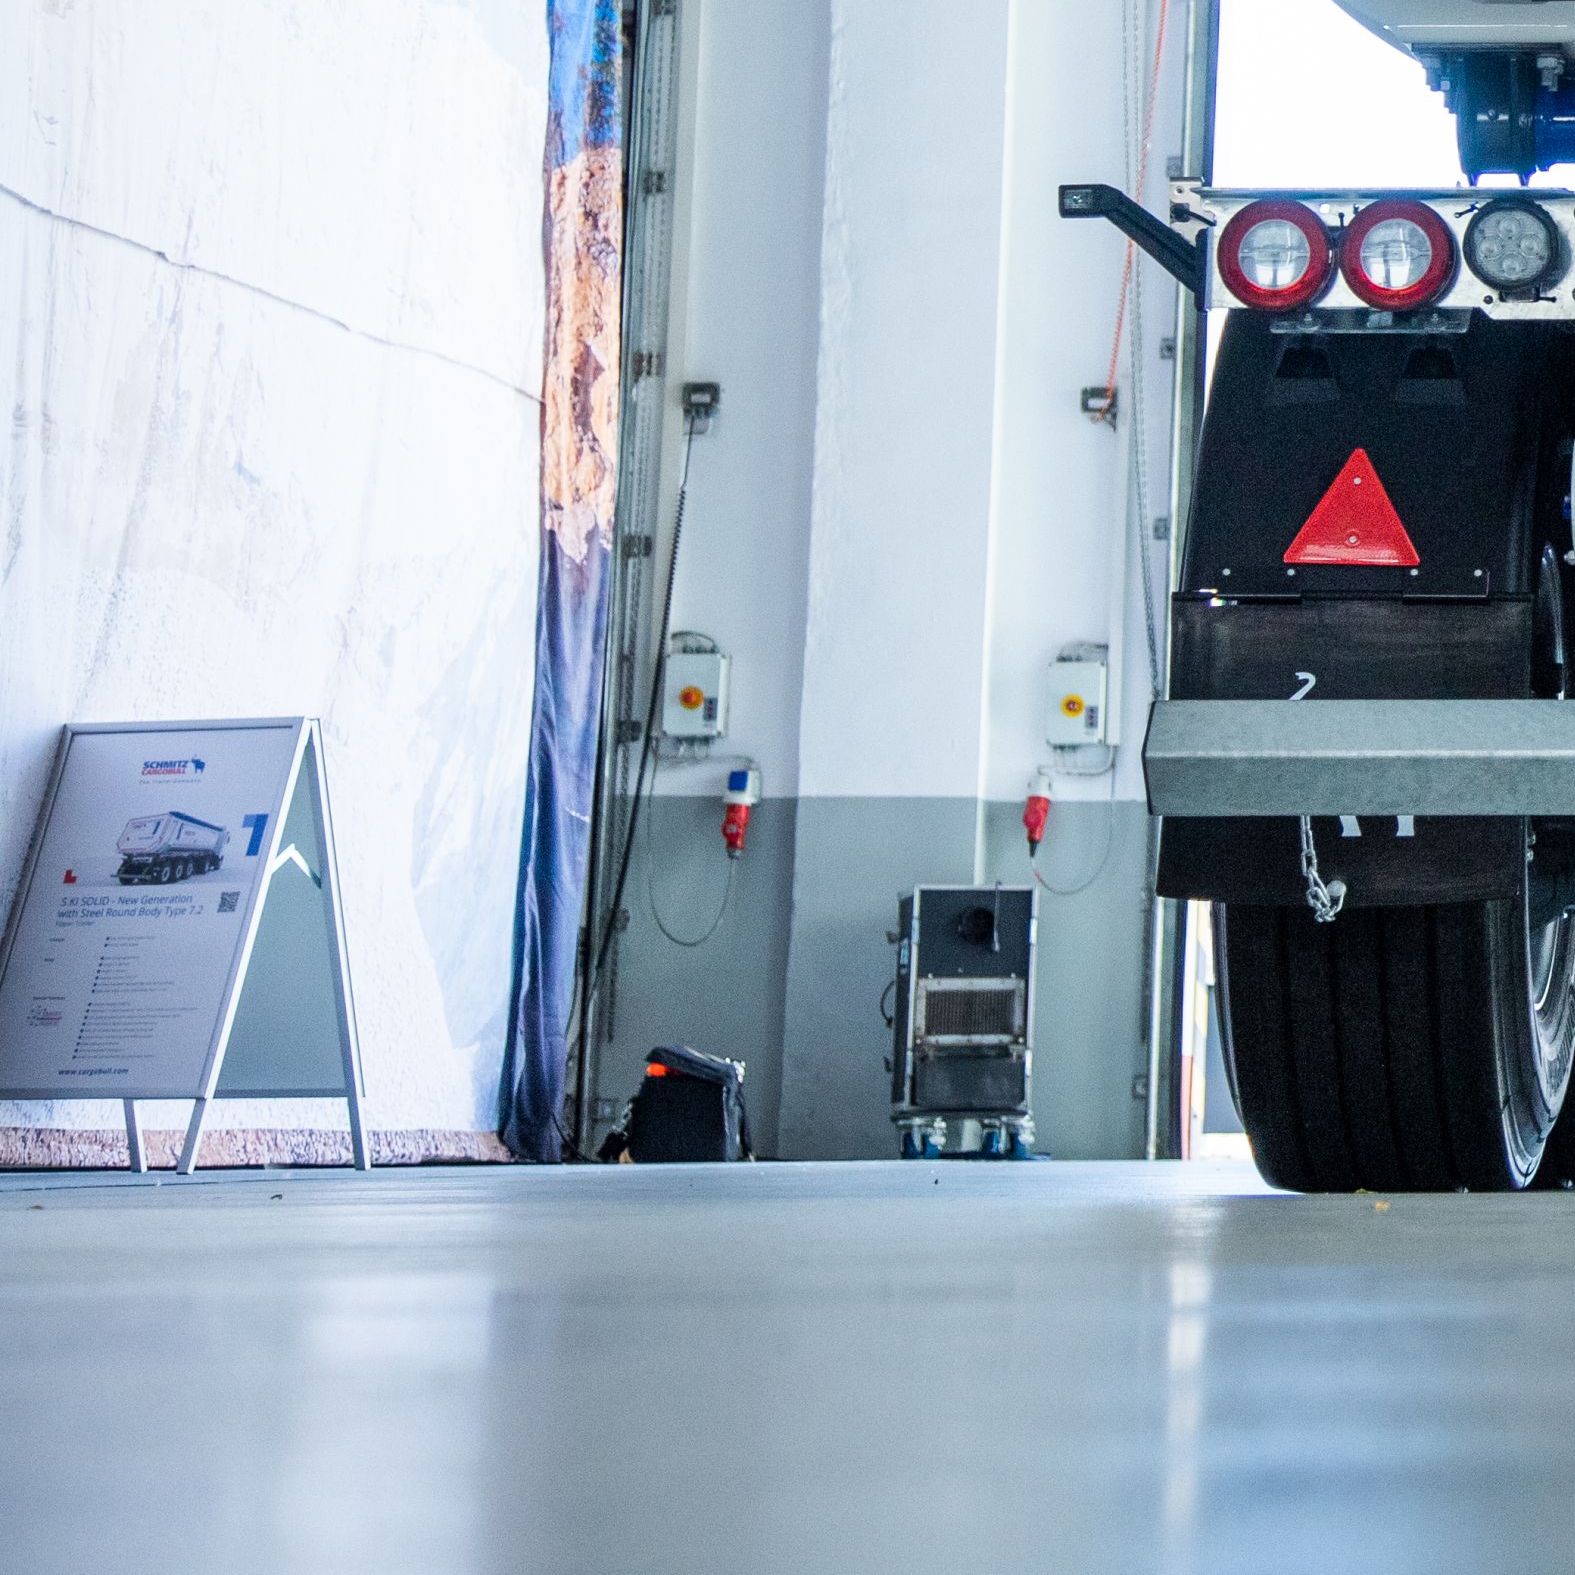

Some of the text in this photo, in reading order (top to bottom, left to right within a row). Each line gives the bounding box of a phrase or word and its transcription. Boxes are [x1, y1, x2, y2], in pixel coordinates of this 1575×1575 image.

[143, 760, 189, 769] SCHMITZ
[117, 896, 140, 905] New
[141, 895, 193, 905] Generation
[57, 904, 204, 919] with Steel Round Body Type 7.2
